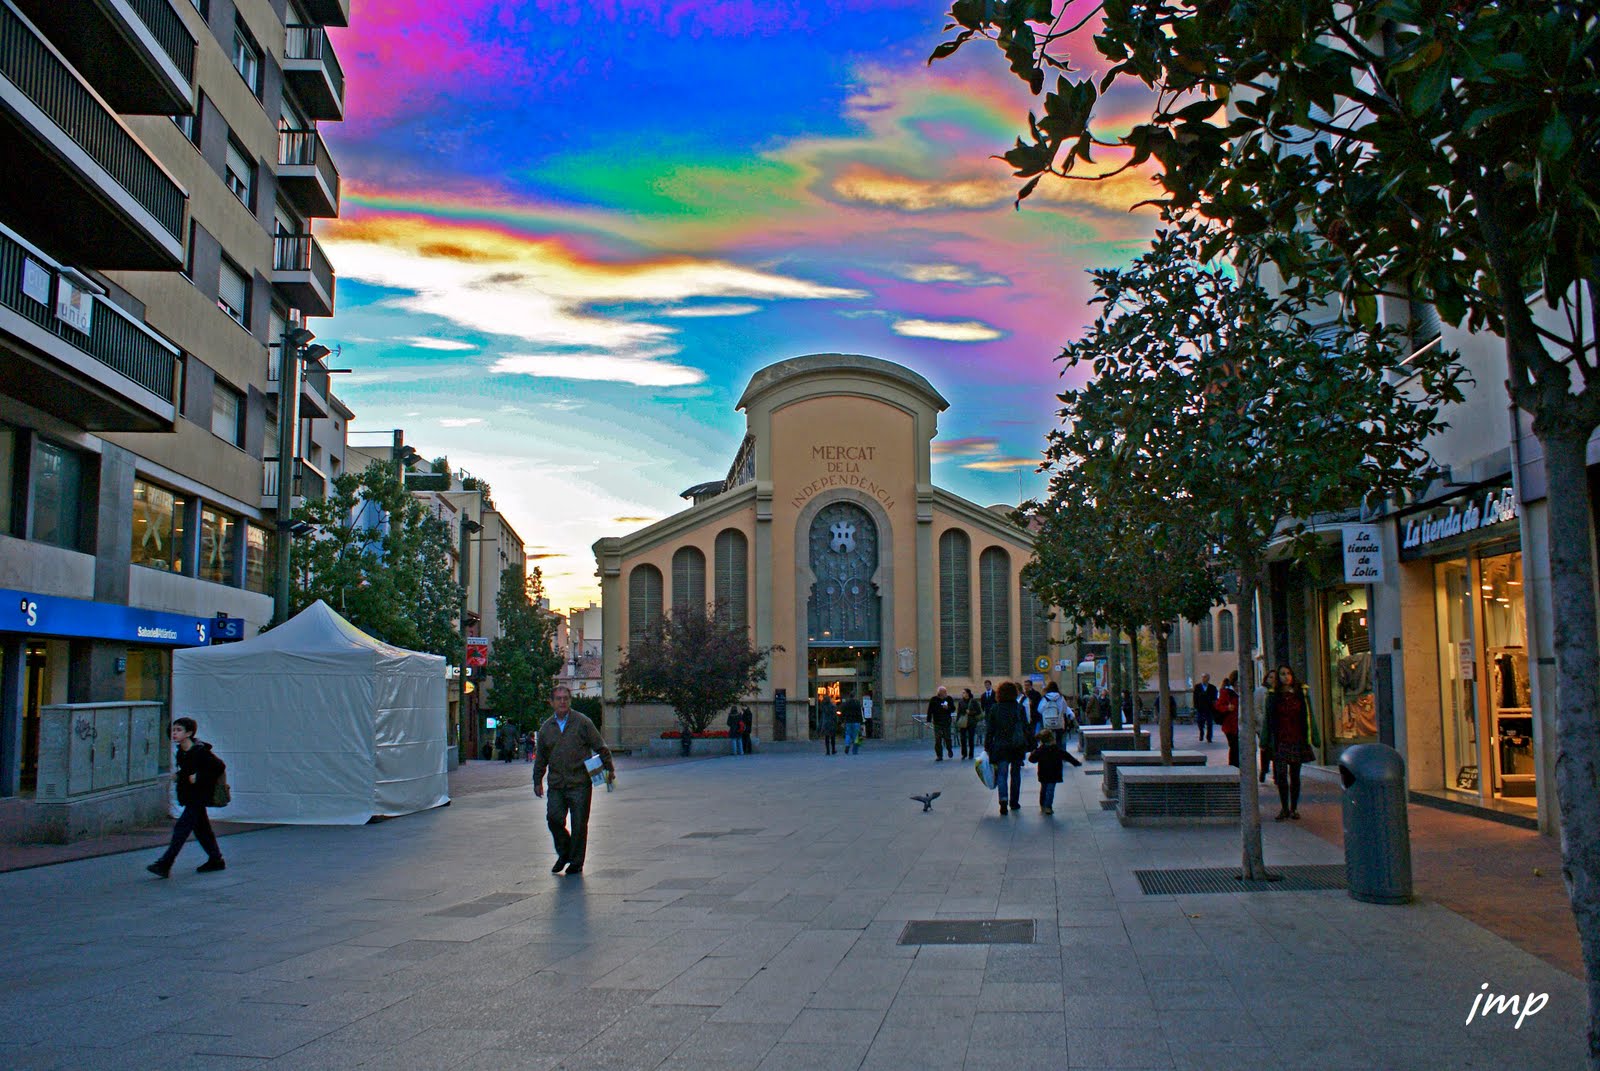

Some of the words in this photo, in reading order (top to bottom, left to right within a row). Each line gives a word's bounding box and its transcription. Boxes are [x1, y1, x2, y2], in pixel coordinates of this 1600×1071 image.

[61, 304, 87, 329] unió
[812, 446, 876, 461] MERCAT
[827, 462, 843, 473] DE
[846, 462, 860, 473] LA
[1403, 519, 1421, 549] La
[1421, 506, 1462, 545] tienda
[1461, 499, 1480, 533] de
[1355, 531, 1370, 541] La
[1347, 543, 1379, 553] tienda
[1358, 555, 1370, 565] de
[1352, 566, 1378, 577] Lolín
[1460, 778, 1472, 789] 54
